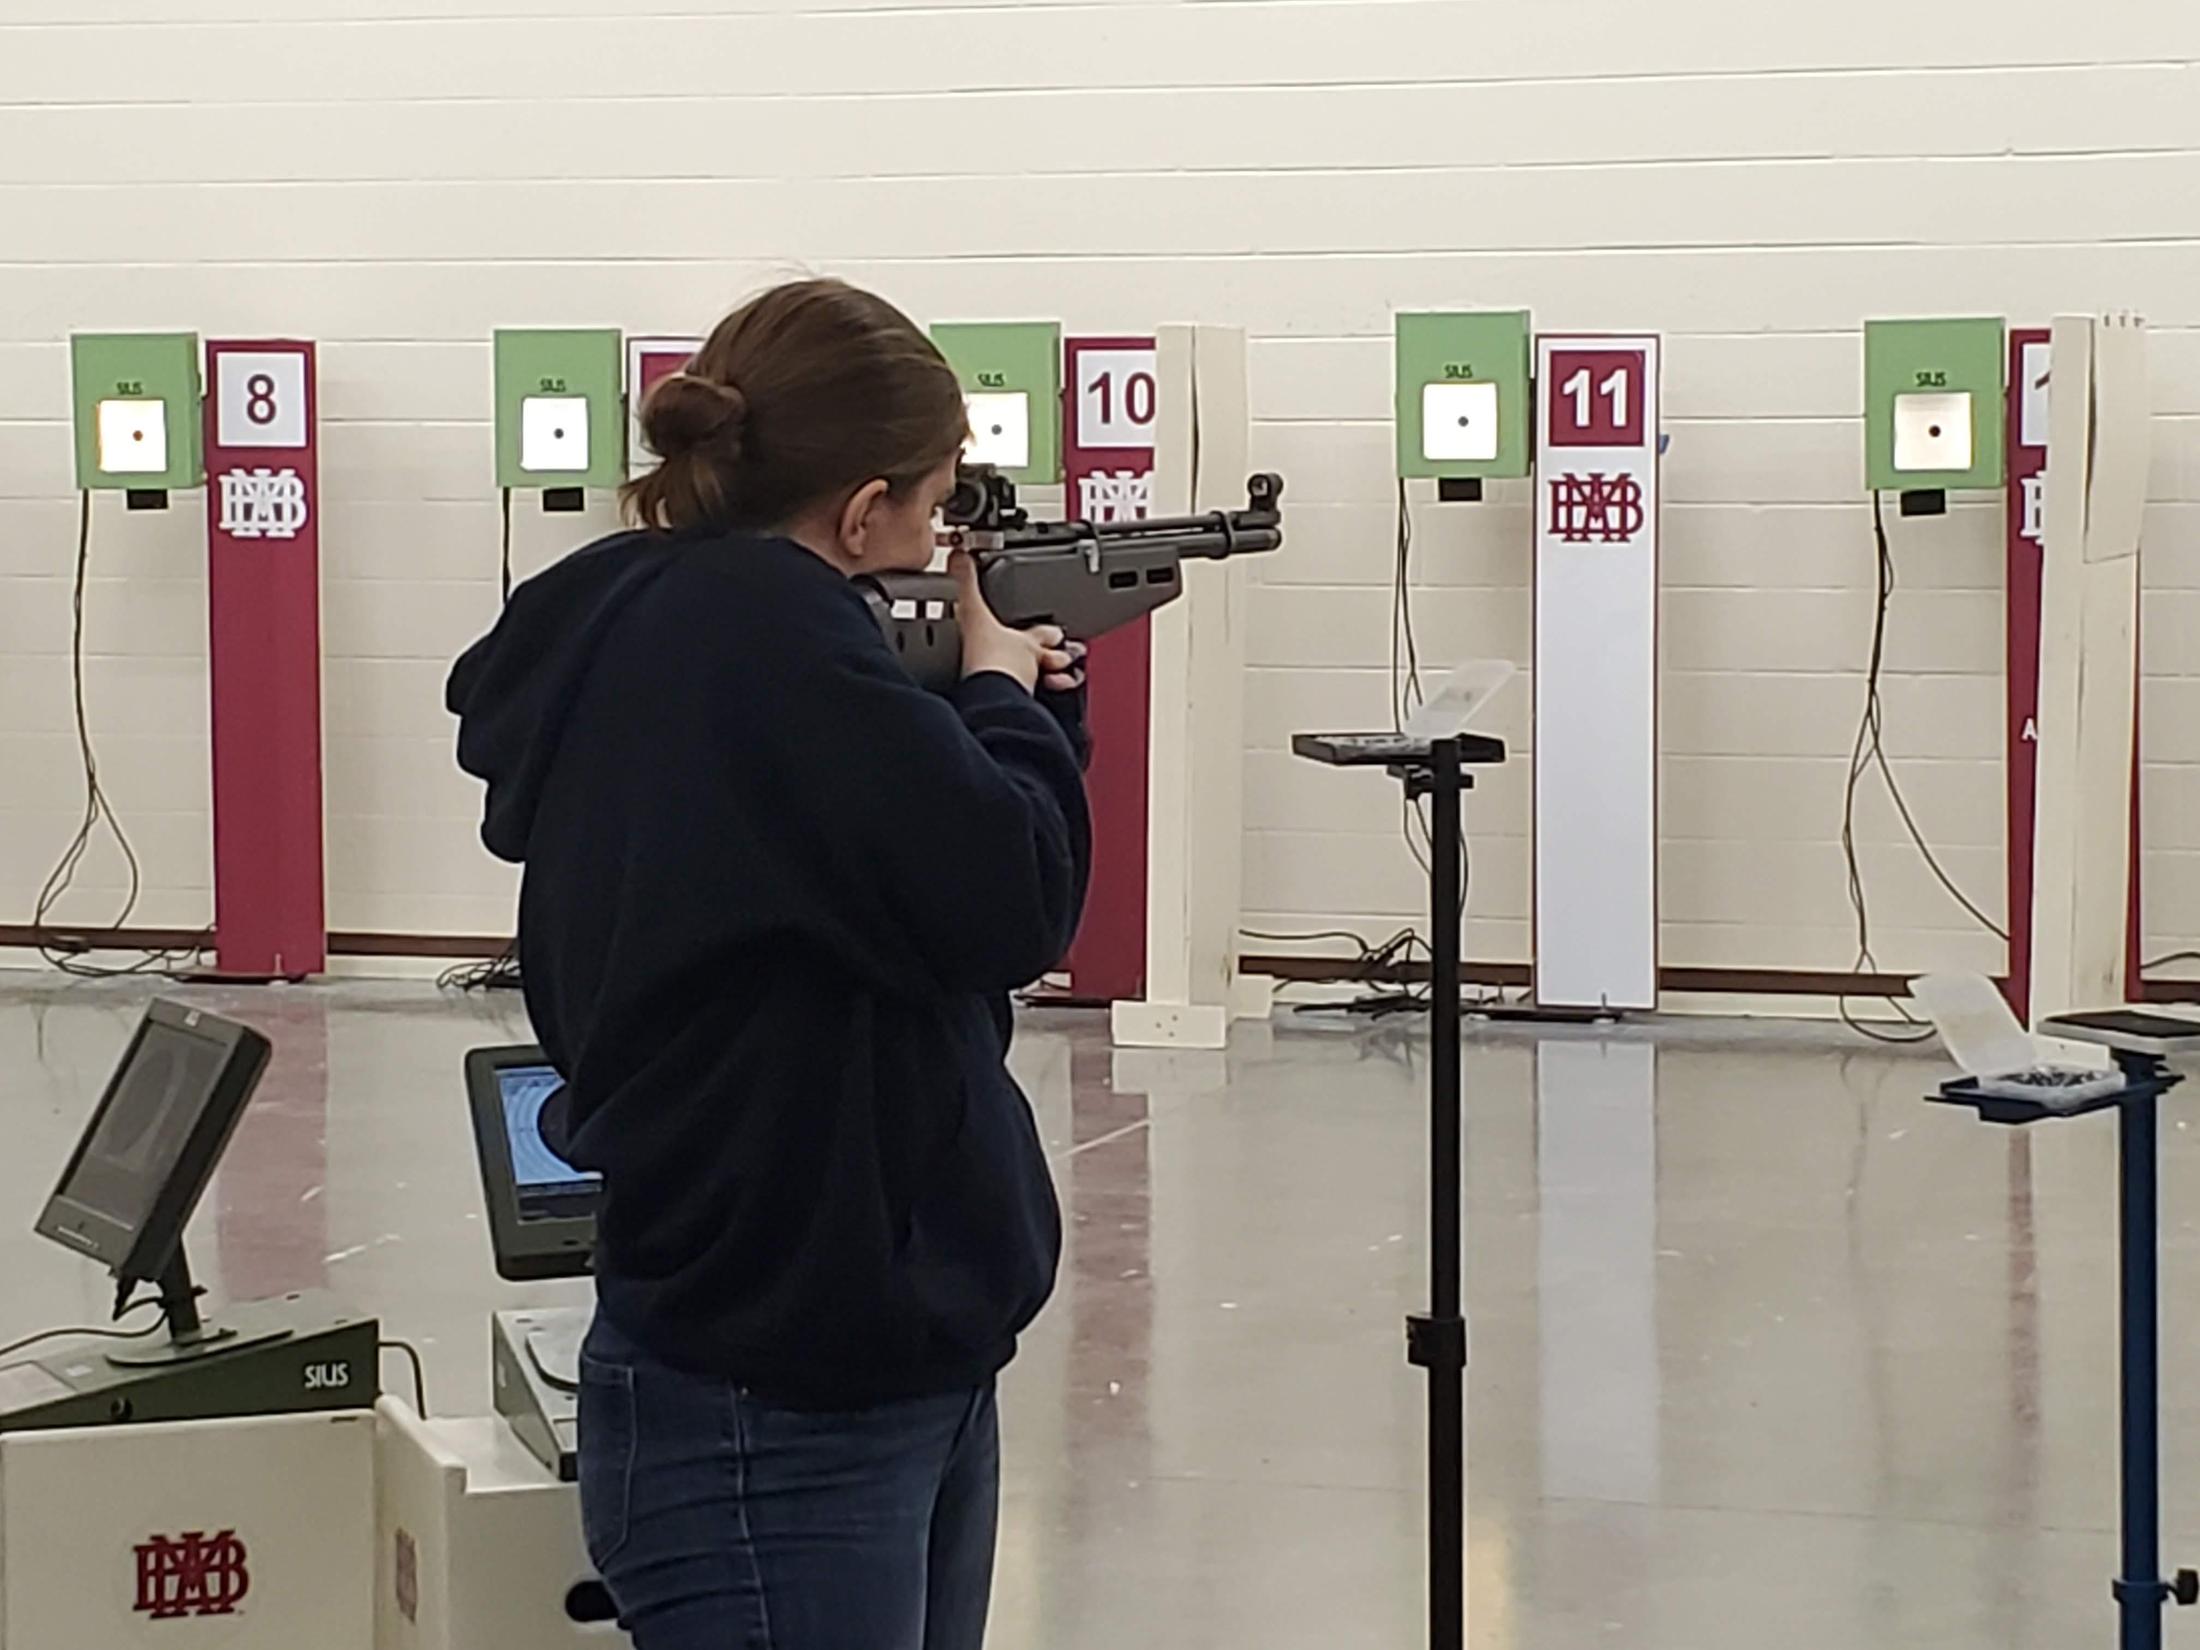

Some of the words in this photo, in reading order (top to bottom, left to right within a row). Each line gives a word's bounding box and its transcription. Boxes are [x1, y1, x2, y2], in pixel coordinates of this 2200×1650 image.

[246, 375, 276, 424] 8
[1088, 371, 1155, 424] 10
[1561, 368, 1629, 428] 11
[304, 1364, 349, 1388] SIUS
